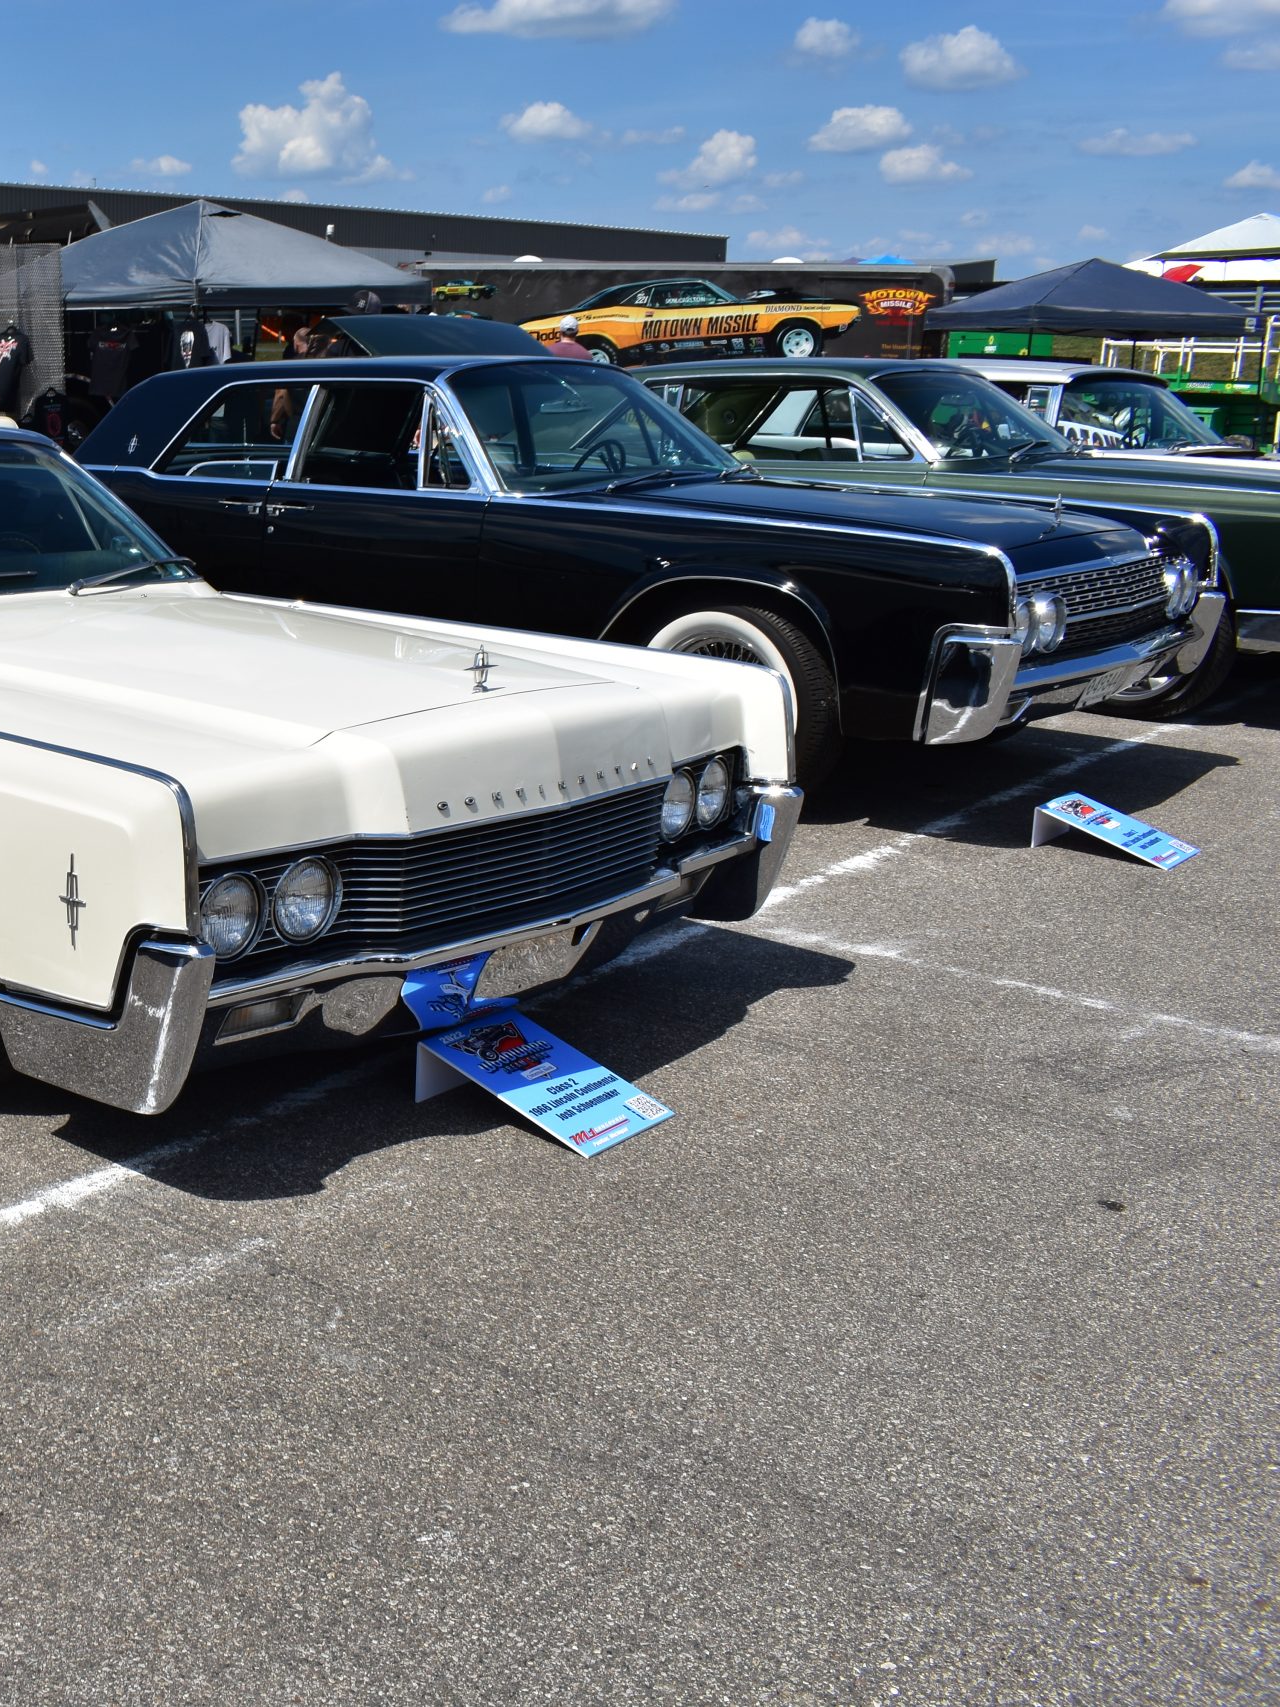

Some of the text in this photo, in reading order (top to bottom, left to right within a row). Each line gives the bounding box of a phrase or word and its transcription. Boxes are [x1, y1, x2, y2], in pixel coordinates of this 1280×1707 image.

[863, 288, 930, 302] MOTOWN
[765, 304, 802, 313] DIAMOND
[880, 299, 913, 309] MISSILE
[529, 327, 562, 342] Dodg
[641, 313, 760, 340] MOTOWN MISSILE
[437, 757, 654, 811] CONTINENTAL
[439, 1031, 465, 1044] 2022
[478, 1040, 553, 1073] WOODWARD
[546, 1078, 579, 1095] Class 2
[529, 1074, 619, 1117] 1966 Lincoln Continental
[555, 1108, 577, 1121] Josh
[574, 1089, 620, 1113] Schoenmaker
